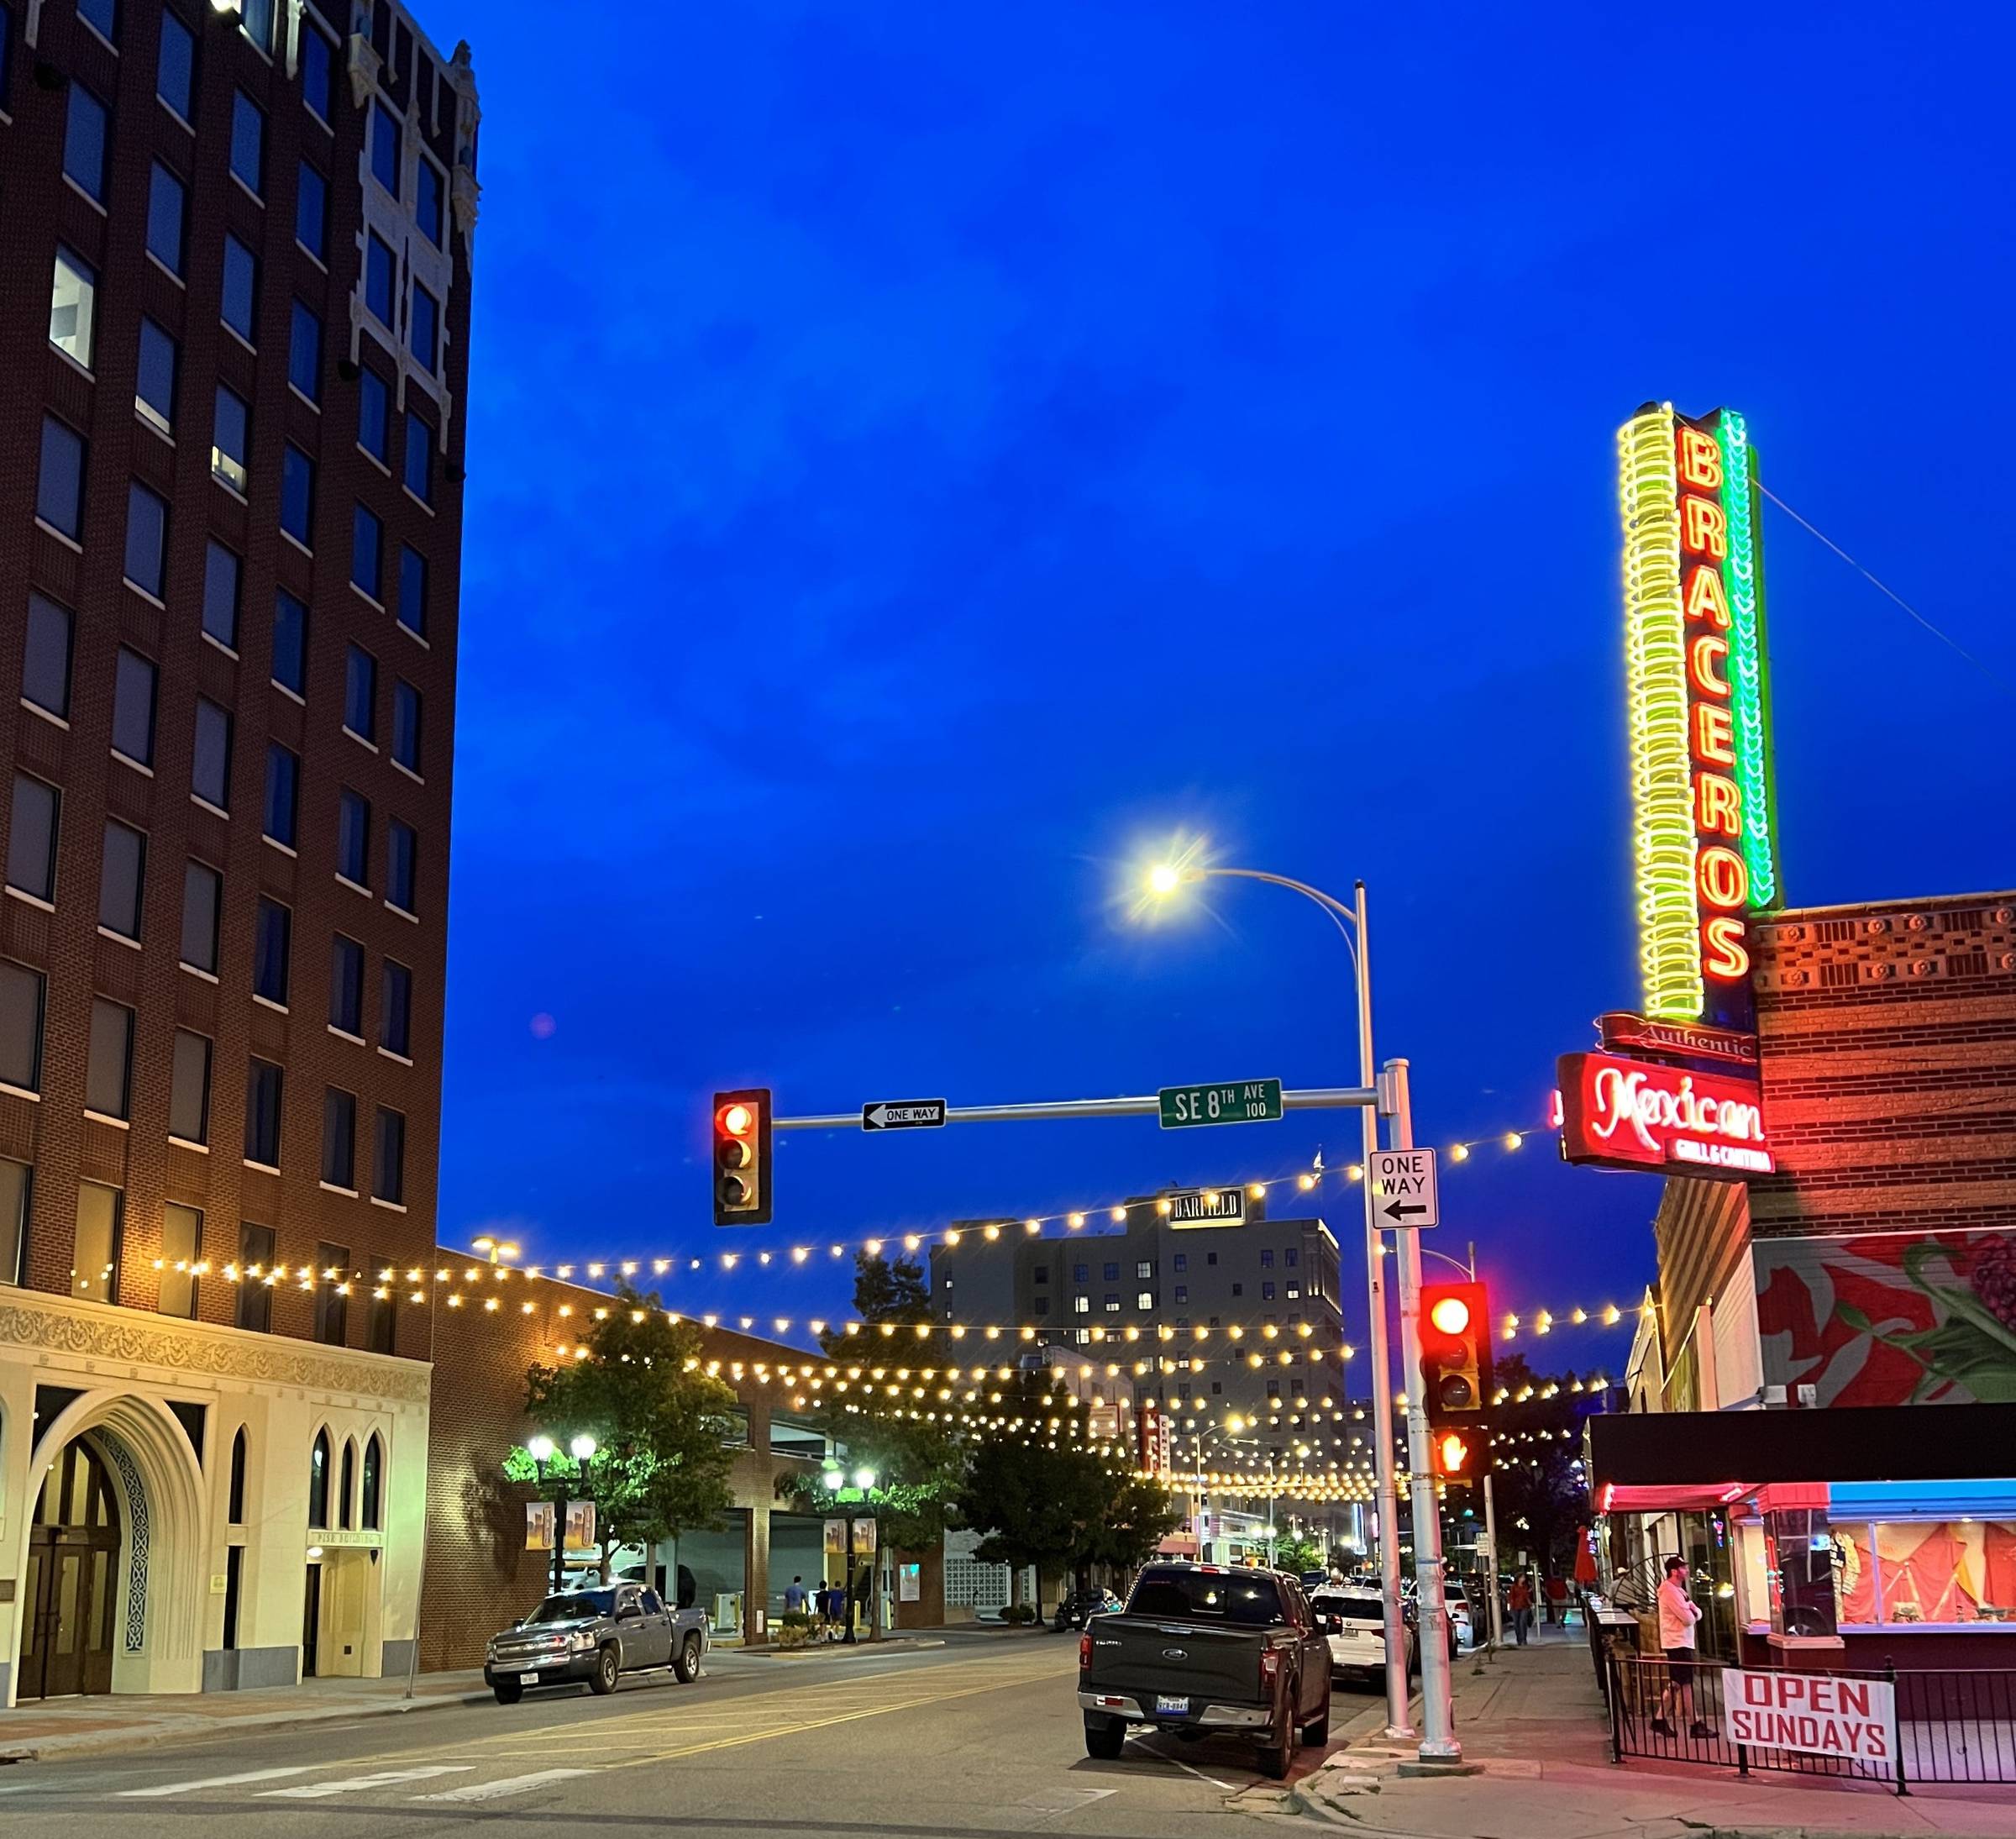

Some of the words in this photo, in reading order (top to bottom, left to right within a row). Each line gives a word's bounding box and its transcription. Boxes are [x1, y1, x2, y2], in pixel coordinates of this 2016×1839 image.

[1678, 427, 1749, 980] BRACEROS
[1640, 1025, 1751, 1056] Authentic
[887, 1110, 909, 1121] ONE
[913, 1108, 936, 1119] WAY
[1175, 1092, 1202, 1121] SE
[1207, 1090, 1235, 1118] 8TH
[1243, 1084, 1265, 1100] AVE
[1246, 1102, 1266, 1117] 100
[1592, 1068, 1765, 1151] Mexican
[1382, 1156, 1424, 1174] ONE
[1382, 1176, 1425, 1195] WAY
[1744, 1674, 1870, 1717] OPEN
[1732, 1710, 1887, 1757] SUNDAYS
